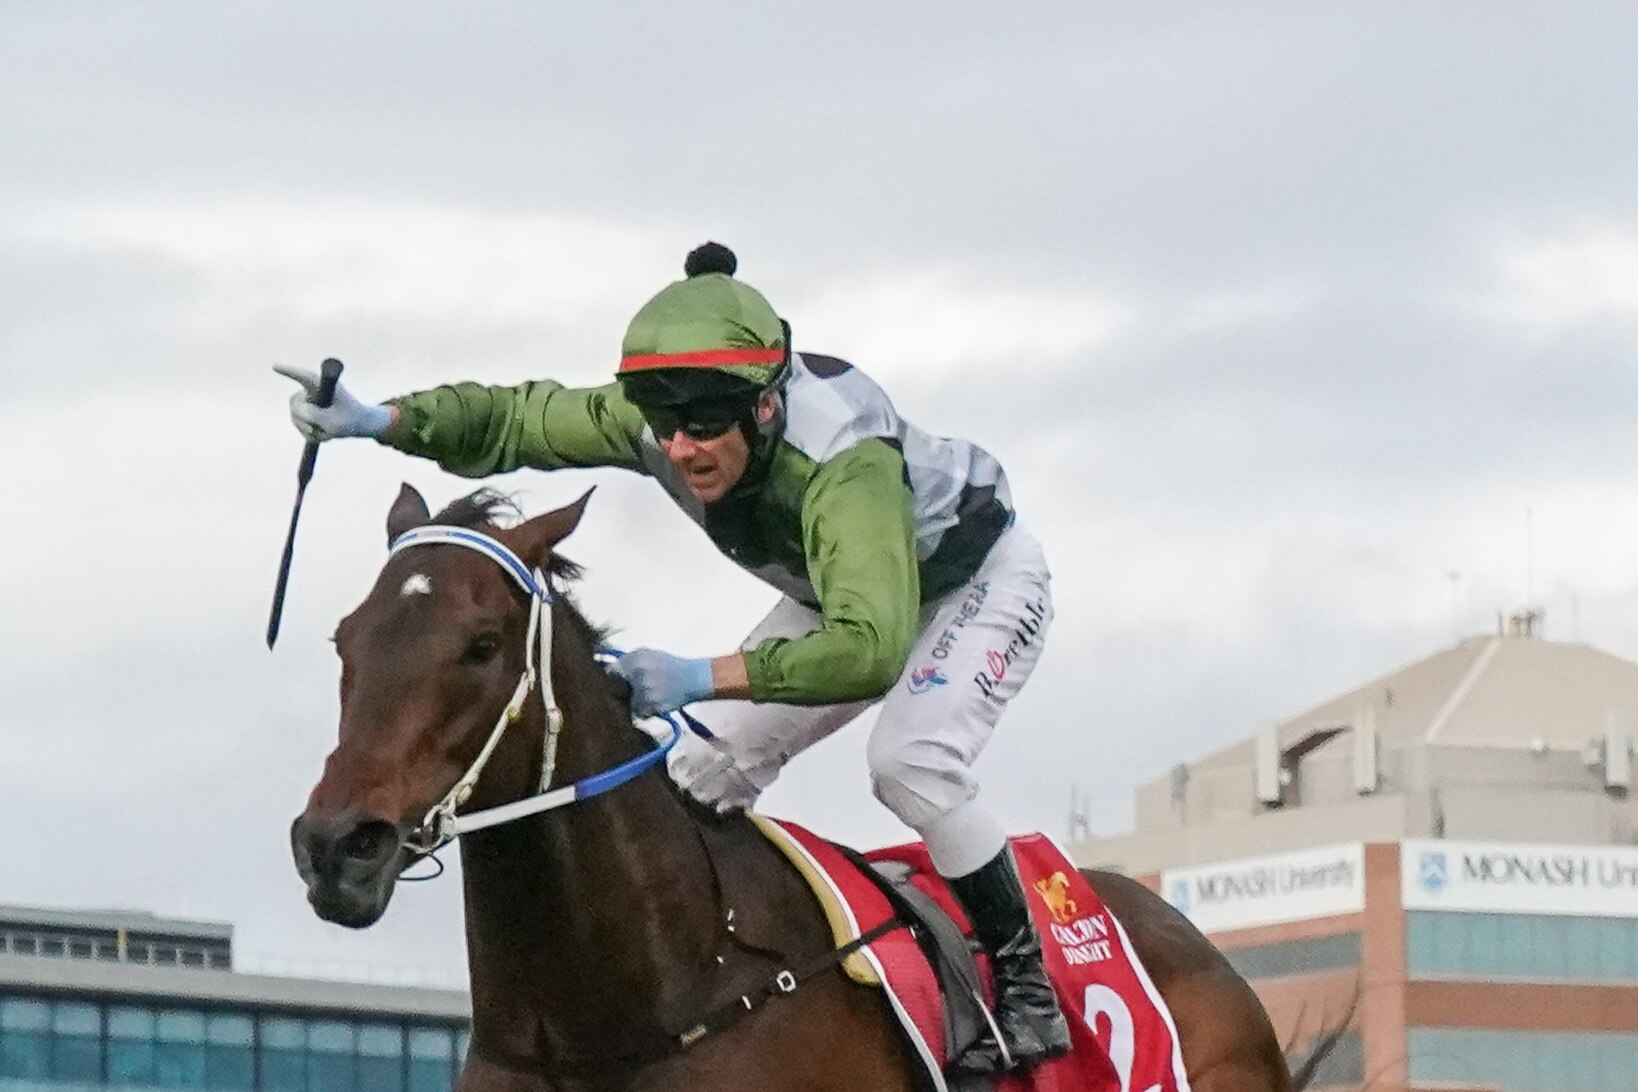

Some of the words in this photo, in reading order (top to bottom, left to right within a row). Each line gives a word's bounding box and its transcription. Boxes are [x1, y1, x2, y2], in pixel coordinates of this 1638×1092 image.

[931, 628, 958, 660] OFF
[1195, 865, 1278, 903] MONASH
[1279, 857, 1356, 896] University
[1463, 850, 1590, 888] MONASH
